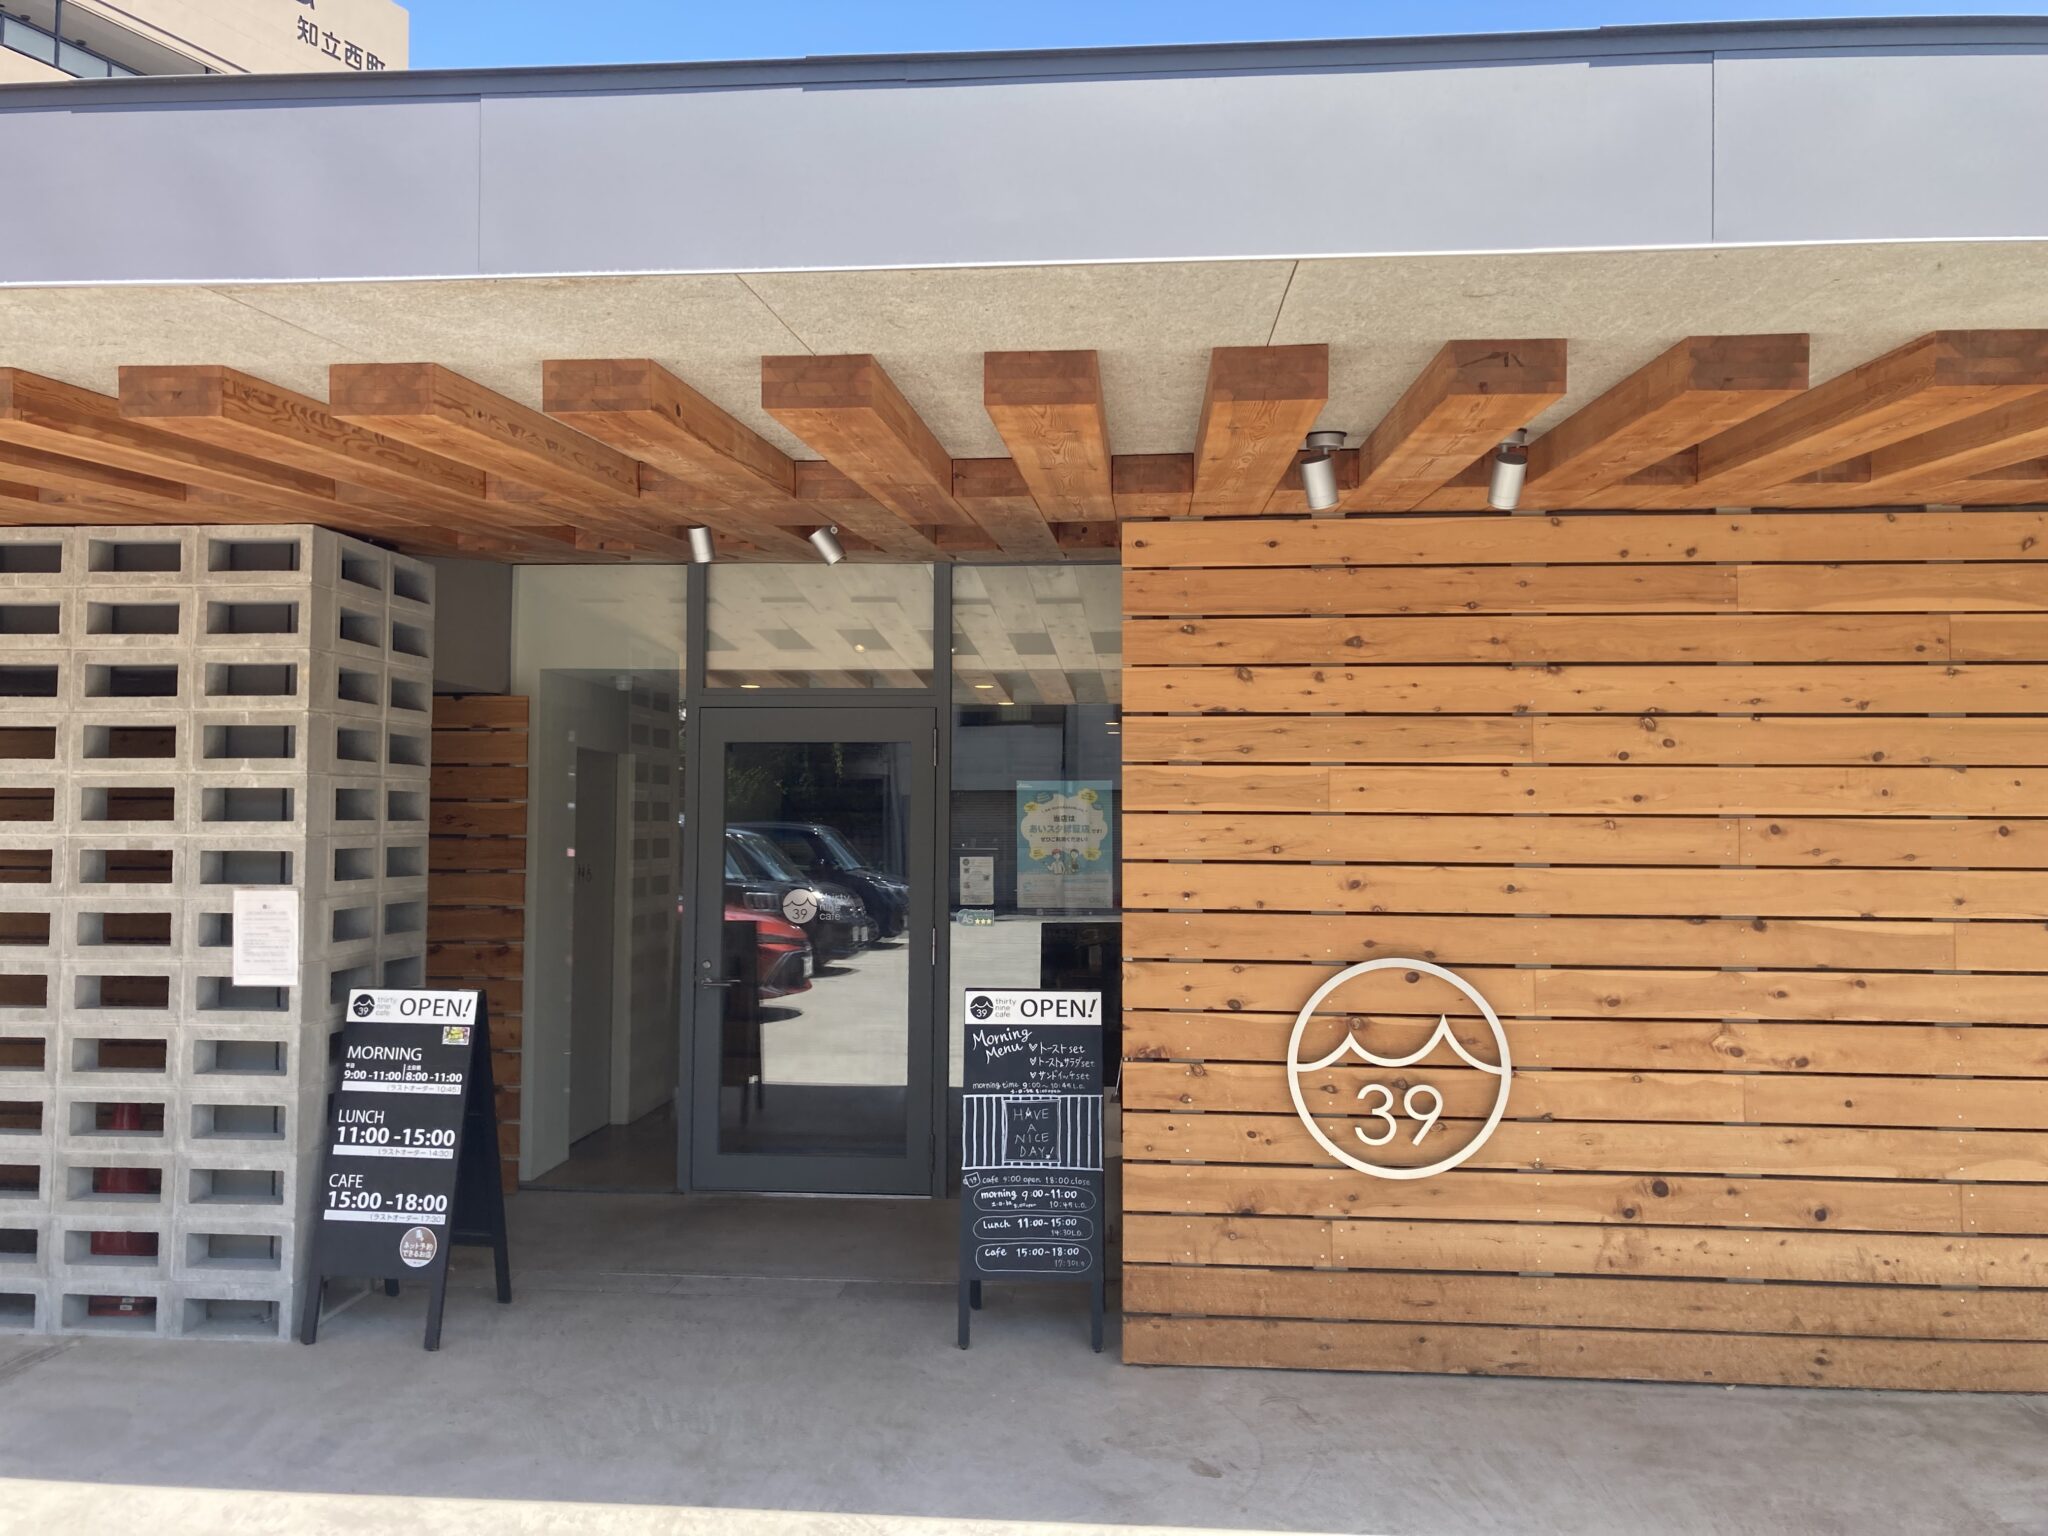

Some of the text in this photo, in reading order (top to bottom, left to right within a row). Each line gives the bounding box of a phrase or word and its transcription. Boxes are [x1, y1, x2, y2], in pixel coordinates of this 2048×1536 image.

[792, 908, 808, 920] 39
[400, 998, 472, 1017] OPEN!
[995, 998, 1016, 1006] thirty
[358, 1007, 369, 1016] 39
[976, 1008, 988, 1017] 39
[1020, 999, 1097, 1018] OPEN!
[972, 1027, 1032, 1050] Morning
[347, 1046, 422, 1061] MORNING
[985, 1042, 1024, 1064] Menu
[344, 1070, 366, 1080] 9:00
[406, 1072, 428, 1082] 8:00
[972, 1081, 1000, 1090] morning
[1002, 1080, 1018, 1088] time
[338, 1109, 385, 1124] LUNCH
[1014, 1107, 1048, 1120] HAVE
[1355, 1084, 1443, 1146] 39
[338, 1126, 390, 1144] 11:00
[1027, 1124, 1036, 1134] A
[1015, 1132, 1048, 1144] NICE
[1020, 1146, 1054, 1160] DAY!
[329, 1174, 364, 1188] CAFE
[982, 1175, 999, 1184] cafe
[1023, 1176, 1042, 1184] open
[1045, 1176, 1070, 1184] 18:00
[1070, 1177, 1090, 1186] close
[328, 1191, 382, 1210] 15:00
[981, 1189, 1017, 1200] morning
[983, 1220, 1011, 1229] lunch
[984, 1247, 1008, 1258] cafe
